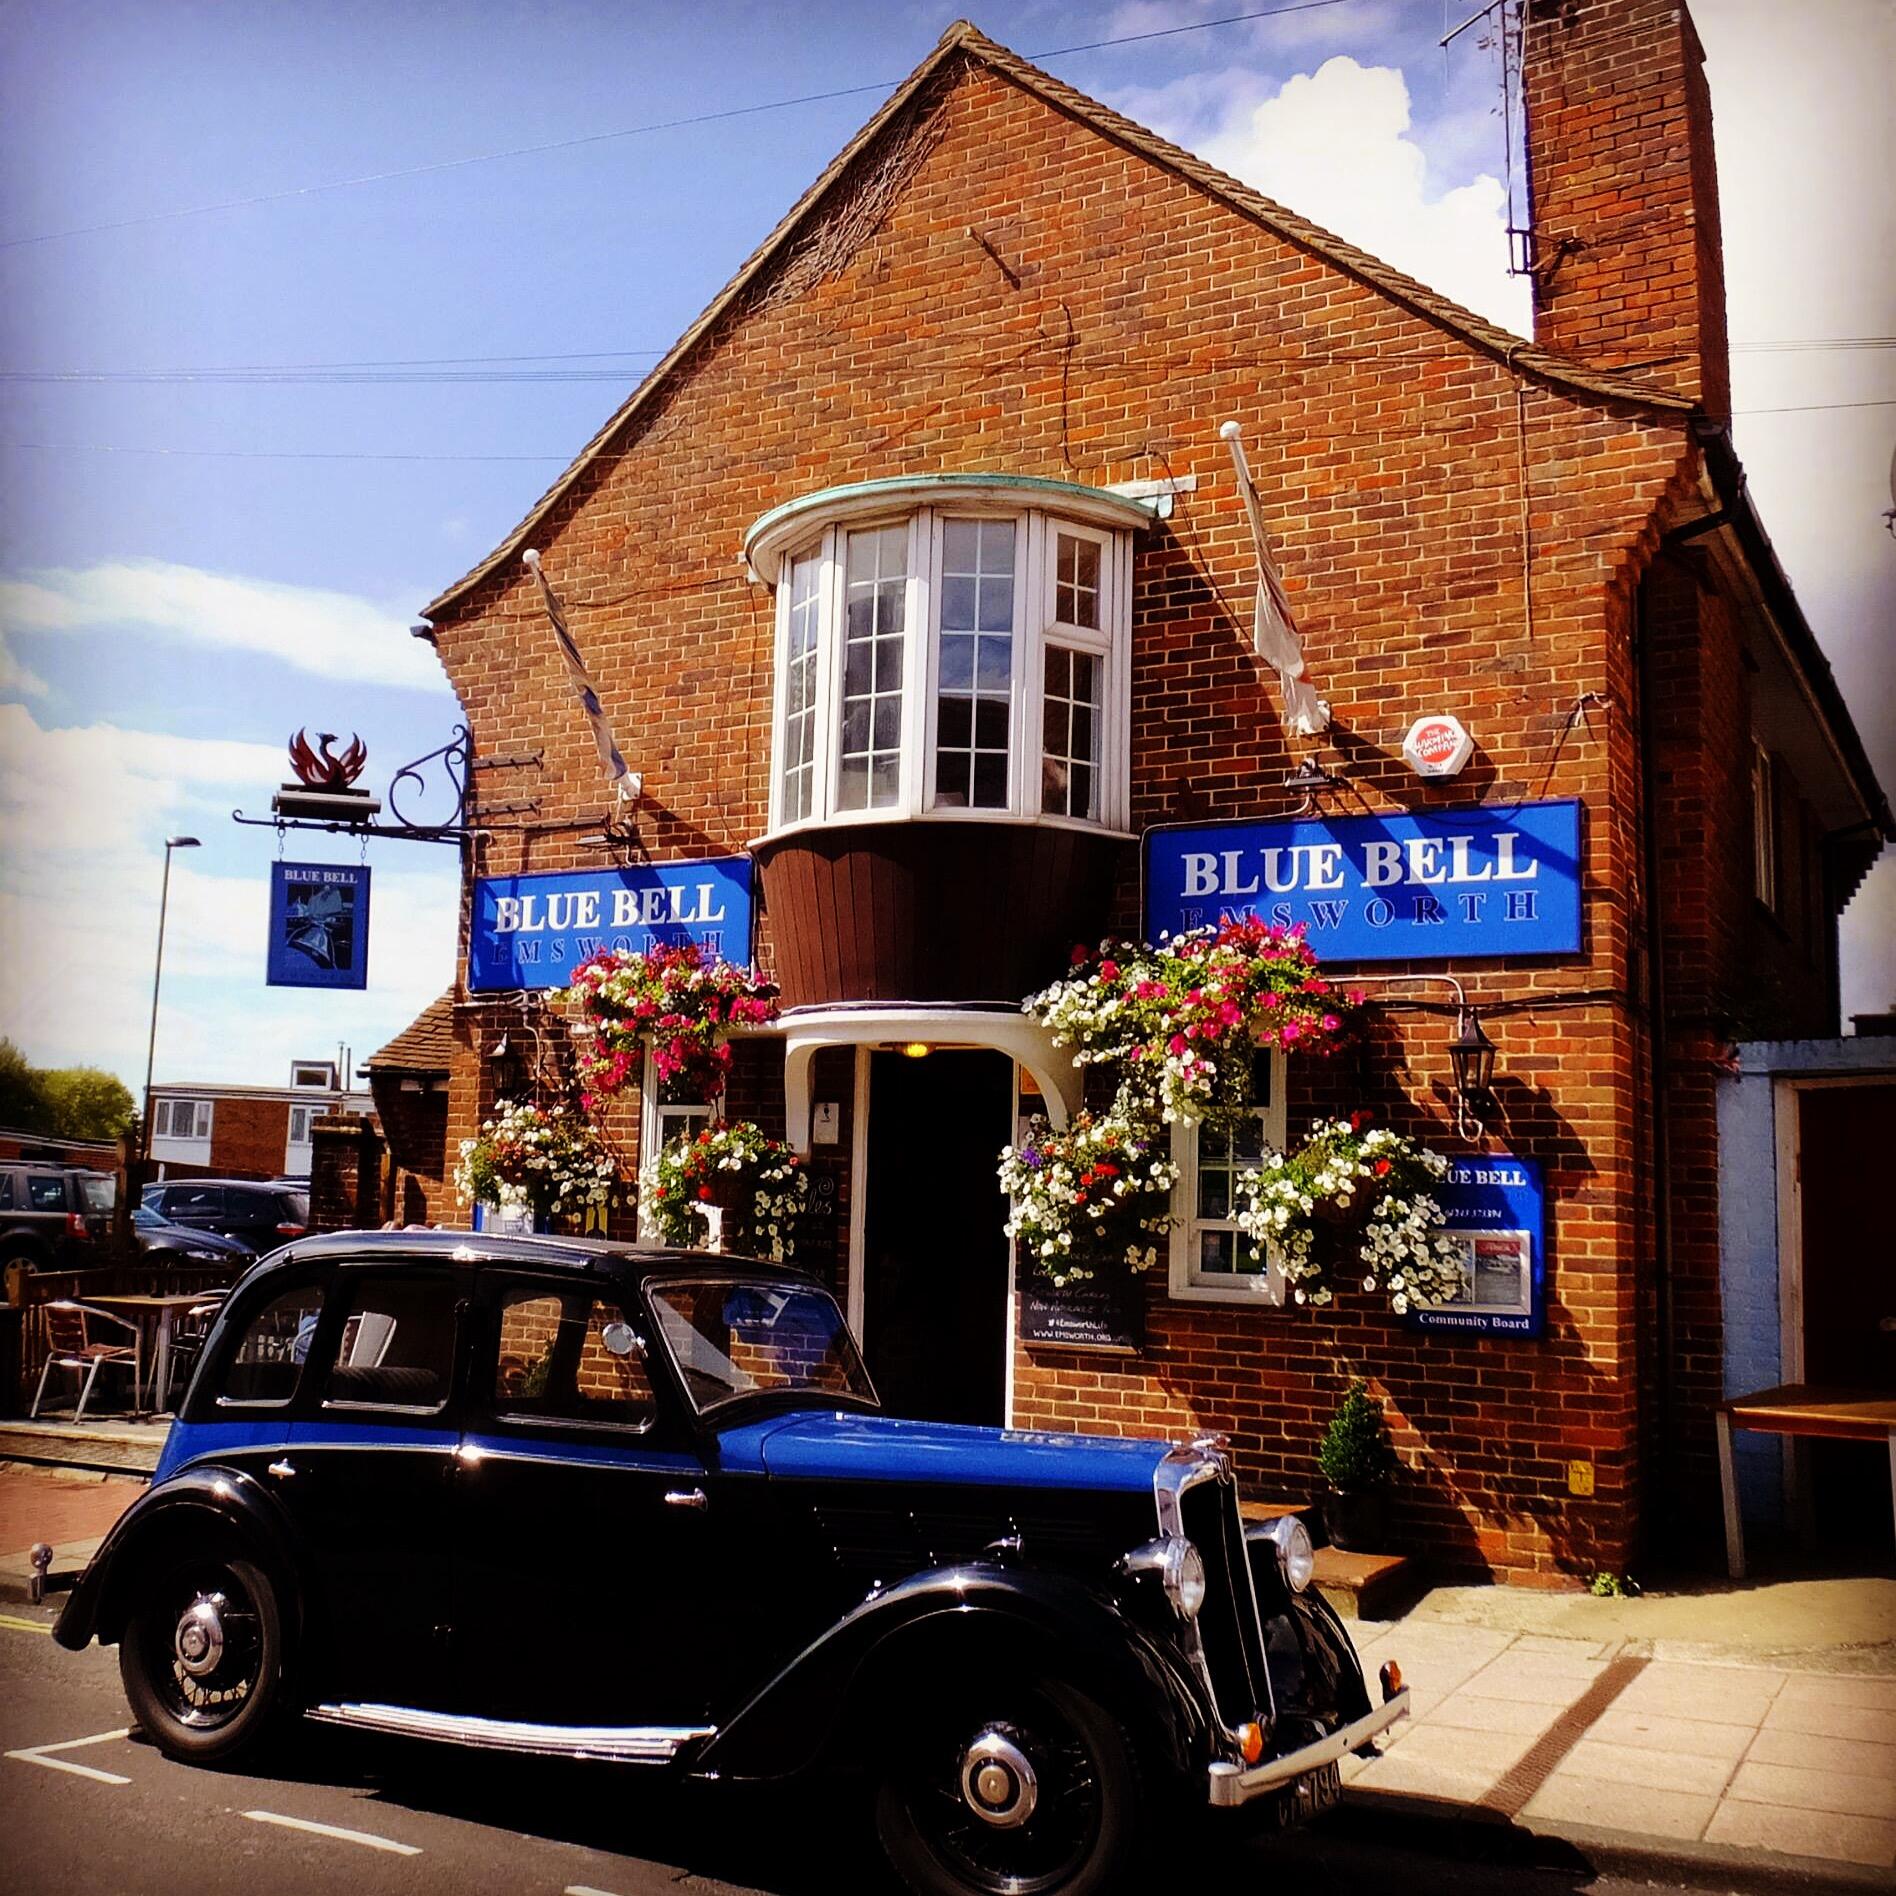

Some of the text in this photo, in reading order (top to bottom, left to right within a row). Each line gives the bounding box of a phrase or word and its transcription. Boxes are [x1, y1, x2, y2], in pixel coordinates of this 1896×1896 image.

[1180, 832, 1538, 897] BLUE BELL
[284, 869, 358, 884] BLUE BELL
[493, 883, 725, 934] BLUE BELL
[1475, 1170, 1527, 1186] BELL
[1419, 1312, 1530, 1330] Community Board
